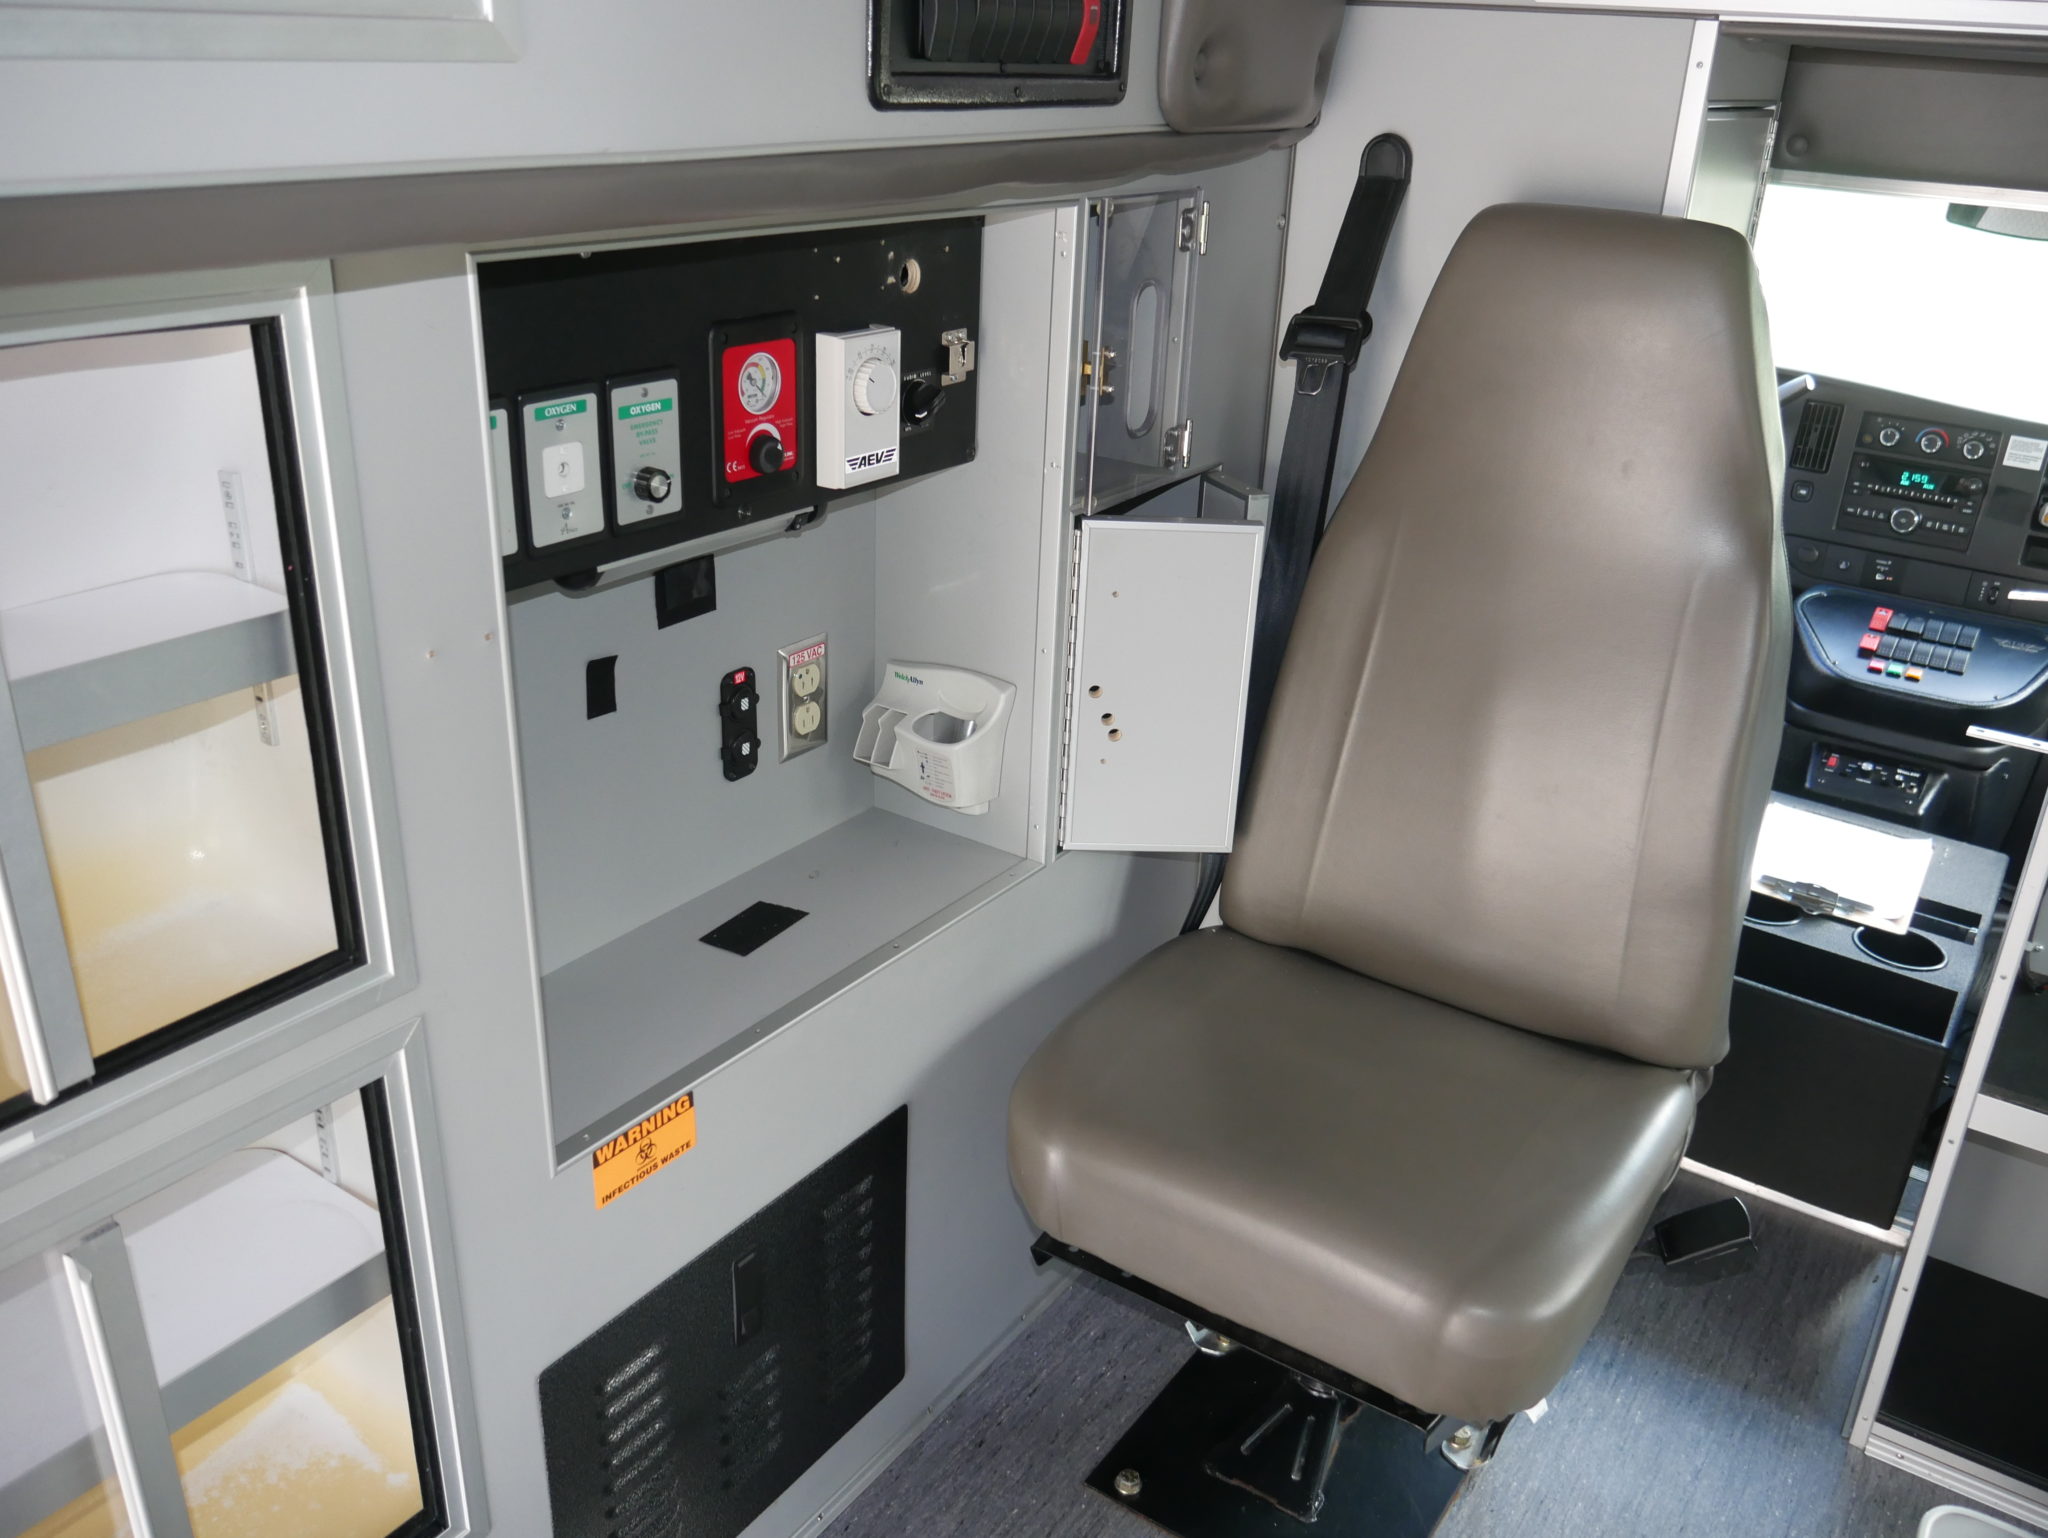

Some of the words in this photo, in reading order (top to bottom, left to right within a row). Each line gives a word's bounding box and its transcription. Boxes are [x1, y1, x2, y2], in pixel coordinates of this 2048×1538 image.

[545, 403, 577, 416] OXYGEN
[630, 402, 662, 415] OXYGEN
[858, 451, 884, 469] AEV
[792, 652, 806, 665] 125
[806, 646, 822, 659] VAC
[594, 1095, 690, 1165] WARNING
[602, 1162, 659, 1205] INFECTIOUS
[661, 1139, 692, 1165] WASTE
